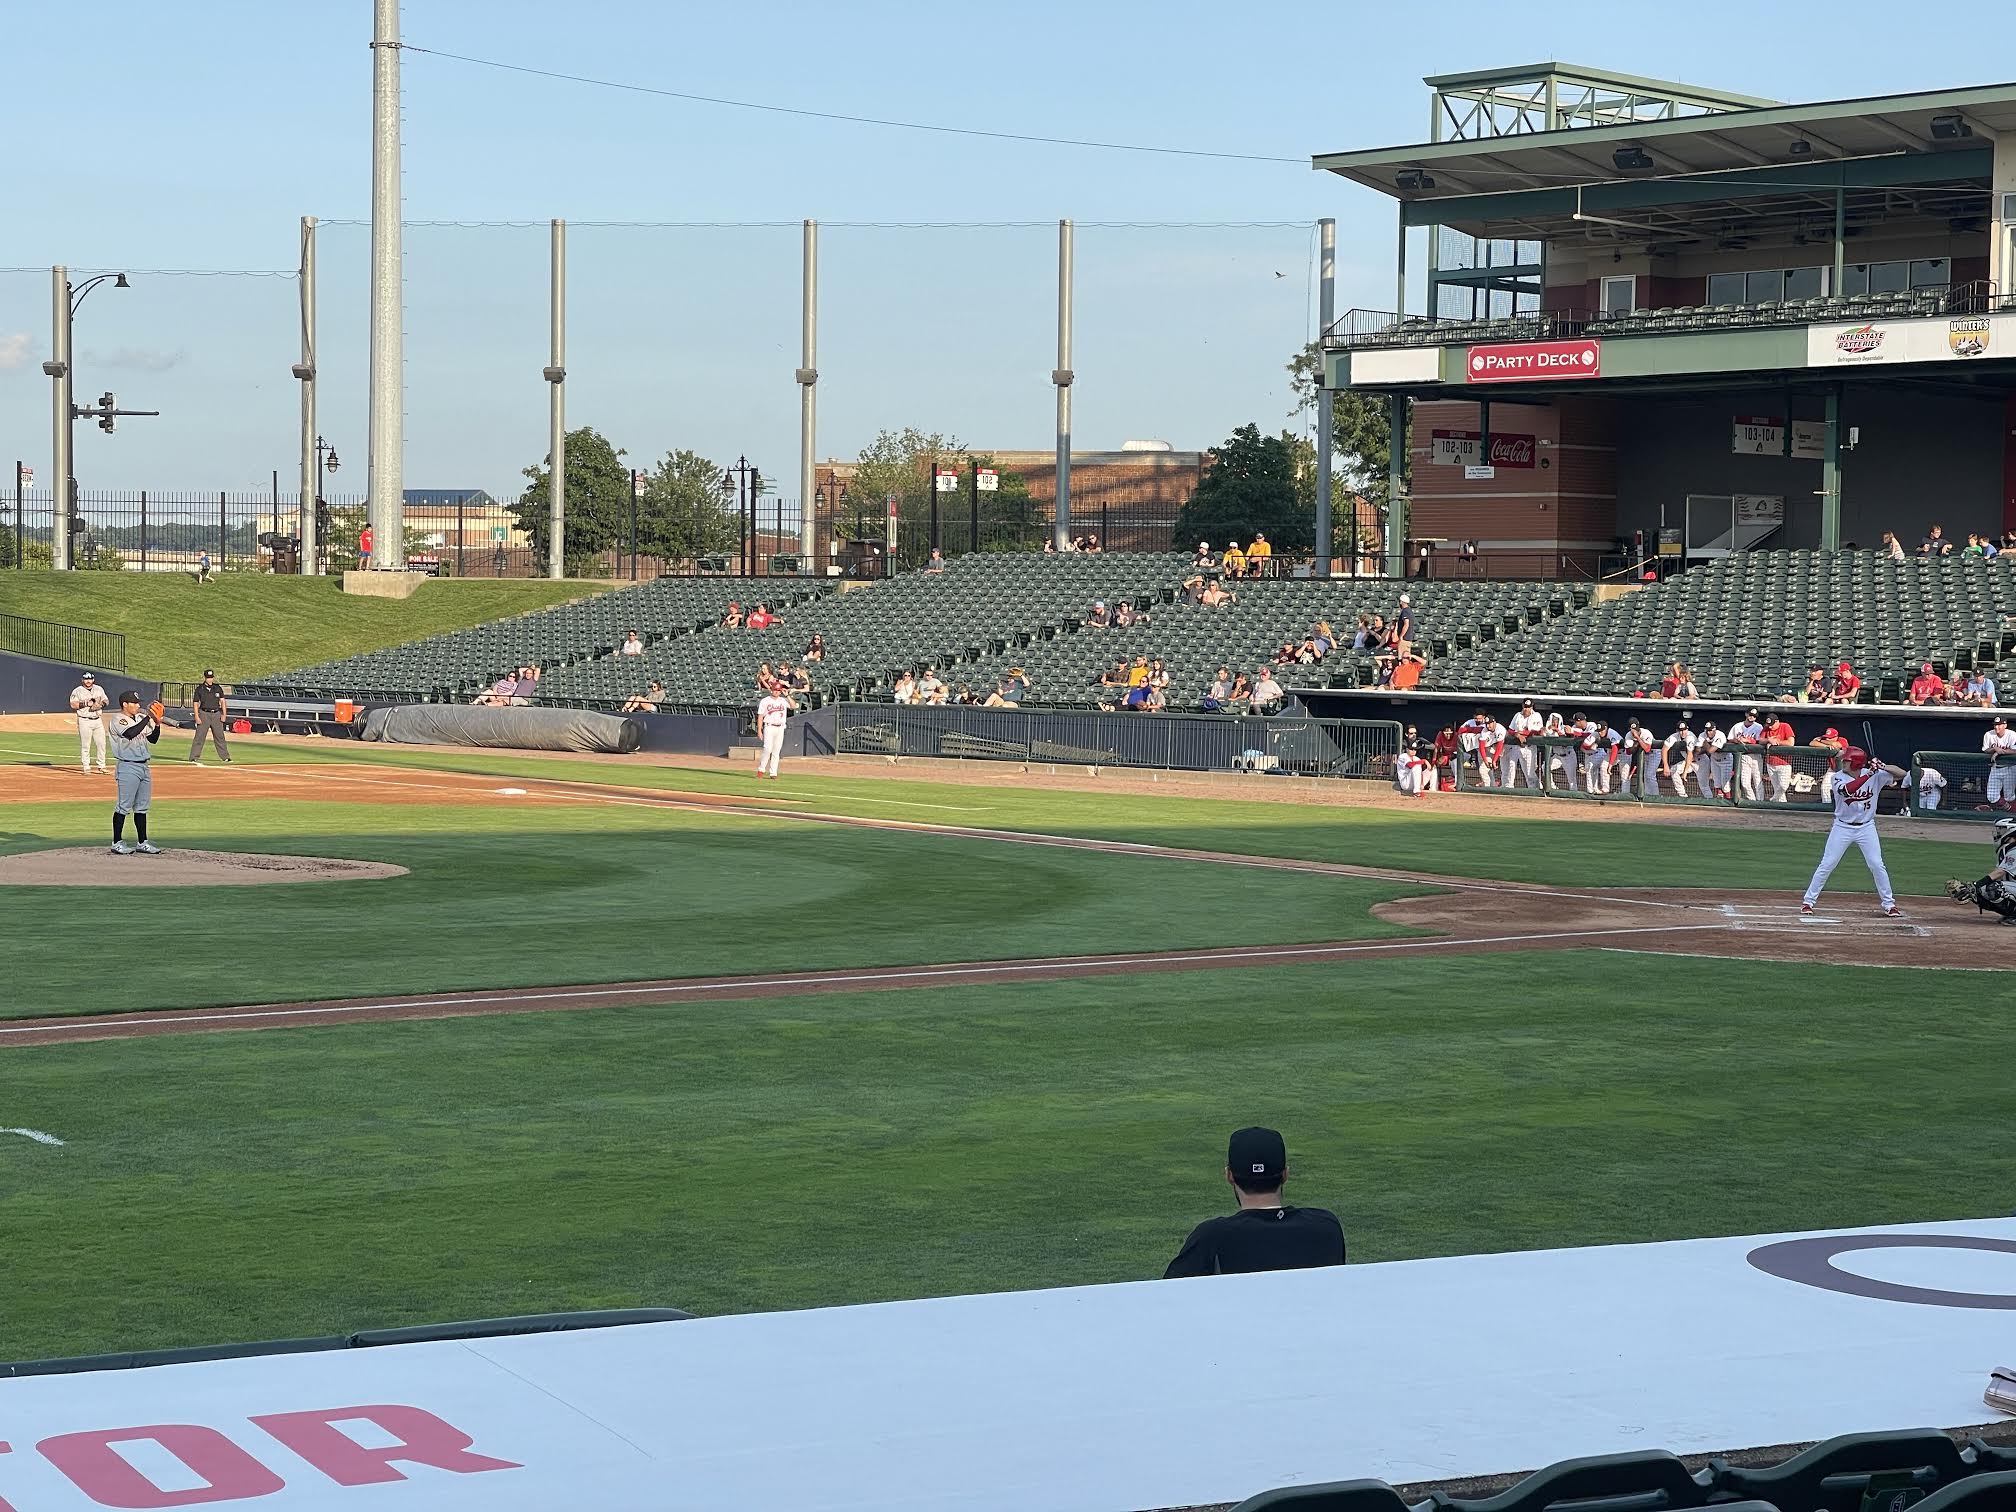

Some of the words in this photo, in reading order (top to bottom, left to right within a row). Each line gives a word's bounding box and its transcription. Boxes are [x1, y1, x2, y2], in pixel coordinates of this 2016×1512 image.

[1836, 332, 1884, 341] INTERSTATE
[1838, 340, 1881, 349] BATTERIES
[1486, 355, 1534, 369] PARTY
[1537, 353, 1580, 367] DECK
[1744, 426, 1775, 442] 103-104
[1441, 440, 1473, 454] 102-103
[1863, 801, 1871, 811] 15
[0, 1404, 526, 1512] OR
